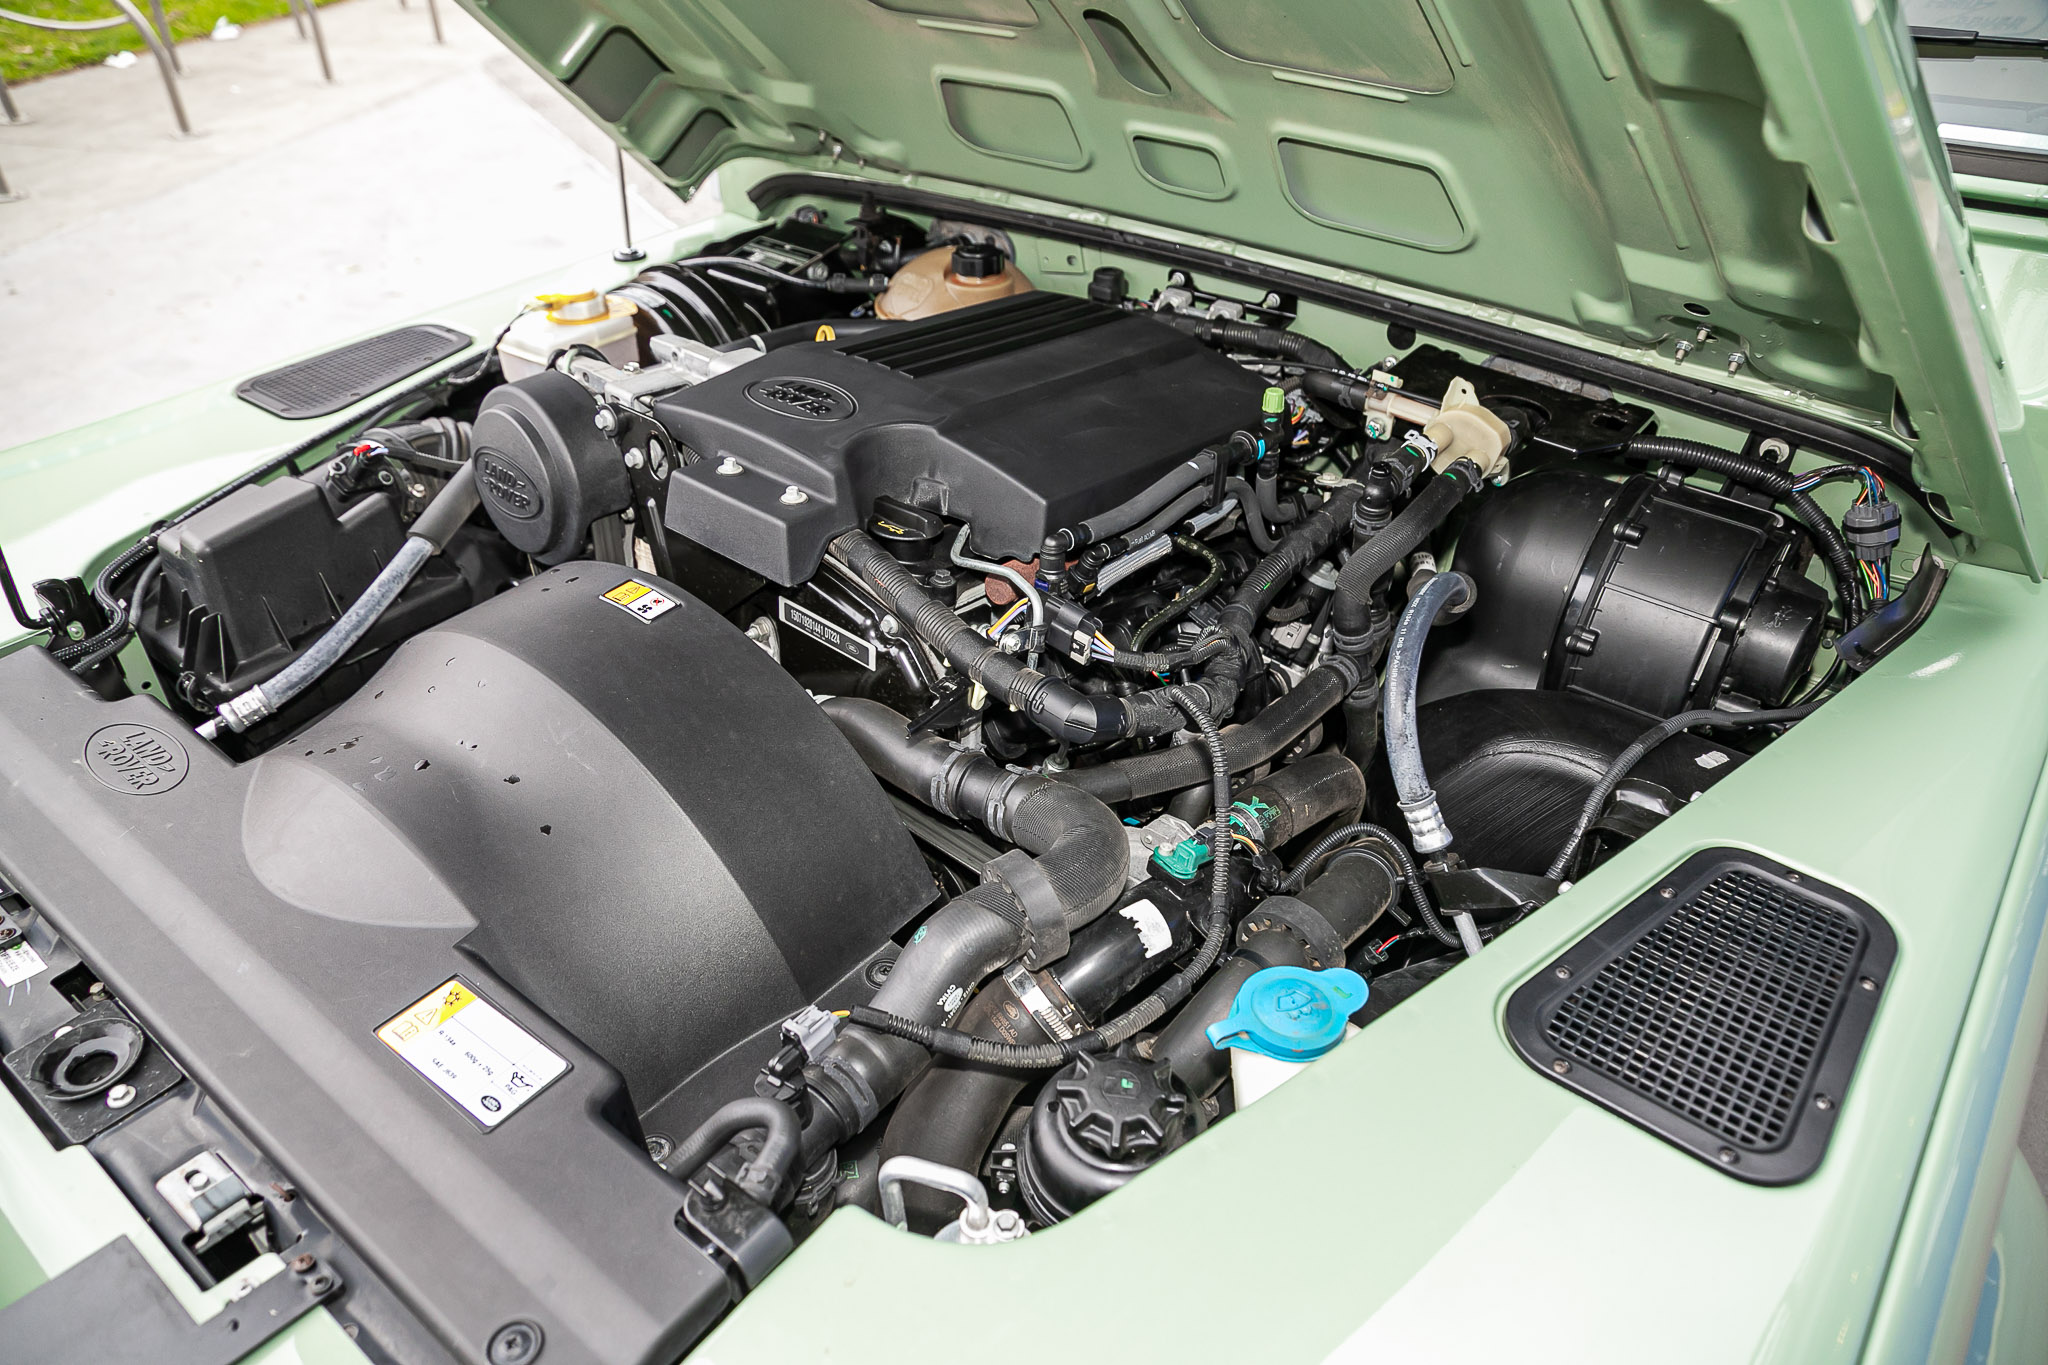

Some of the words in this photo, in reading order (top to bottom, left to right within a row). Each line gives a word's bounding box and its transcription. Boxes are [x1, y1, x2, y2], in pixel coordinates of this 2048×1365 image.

[484, 458, 517, 488] LAND
[489, 477, 531, 511] ROVER
[119, 731, 173, 766] LAND
[97, 742, 160, 790] ROVER
